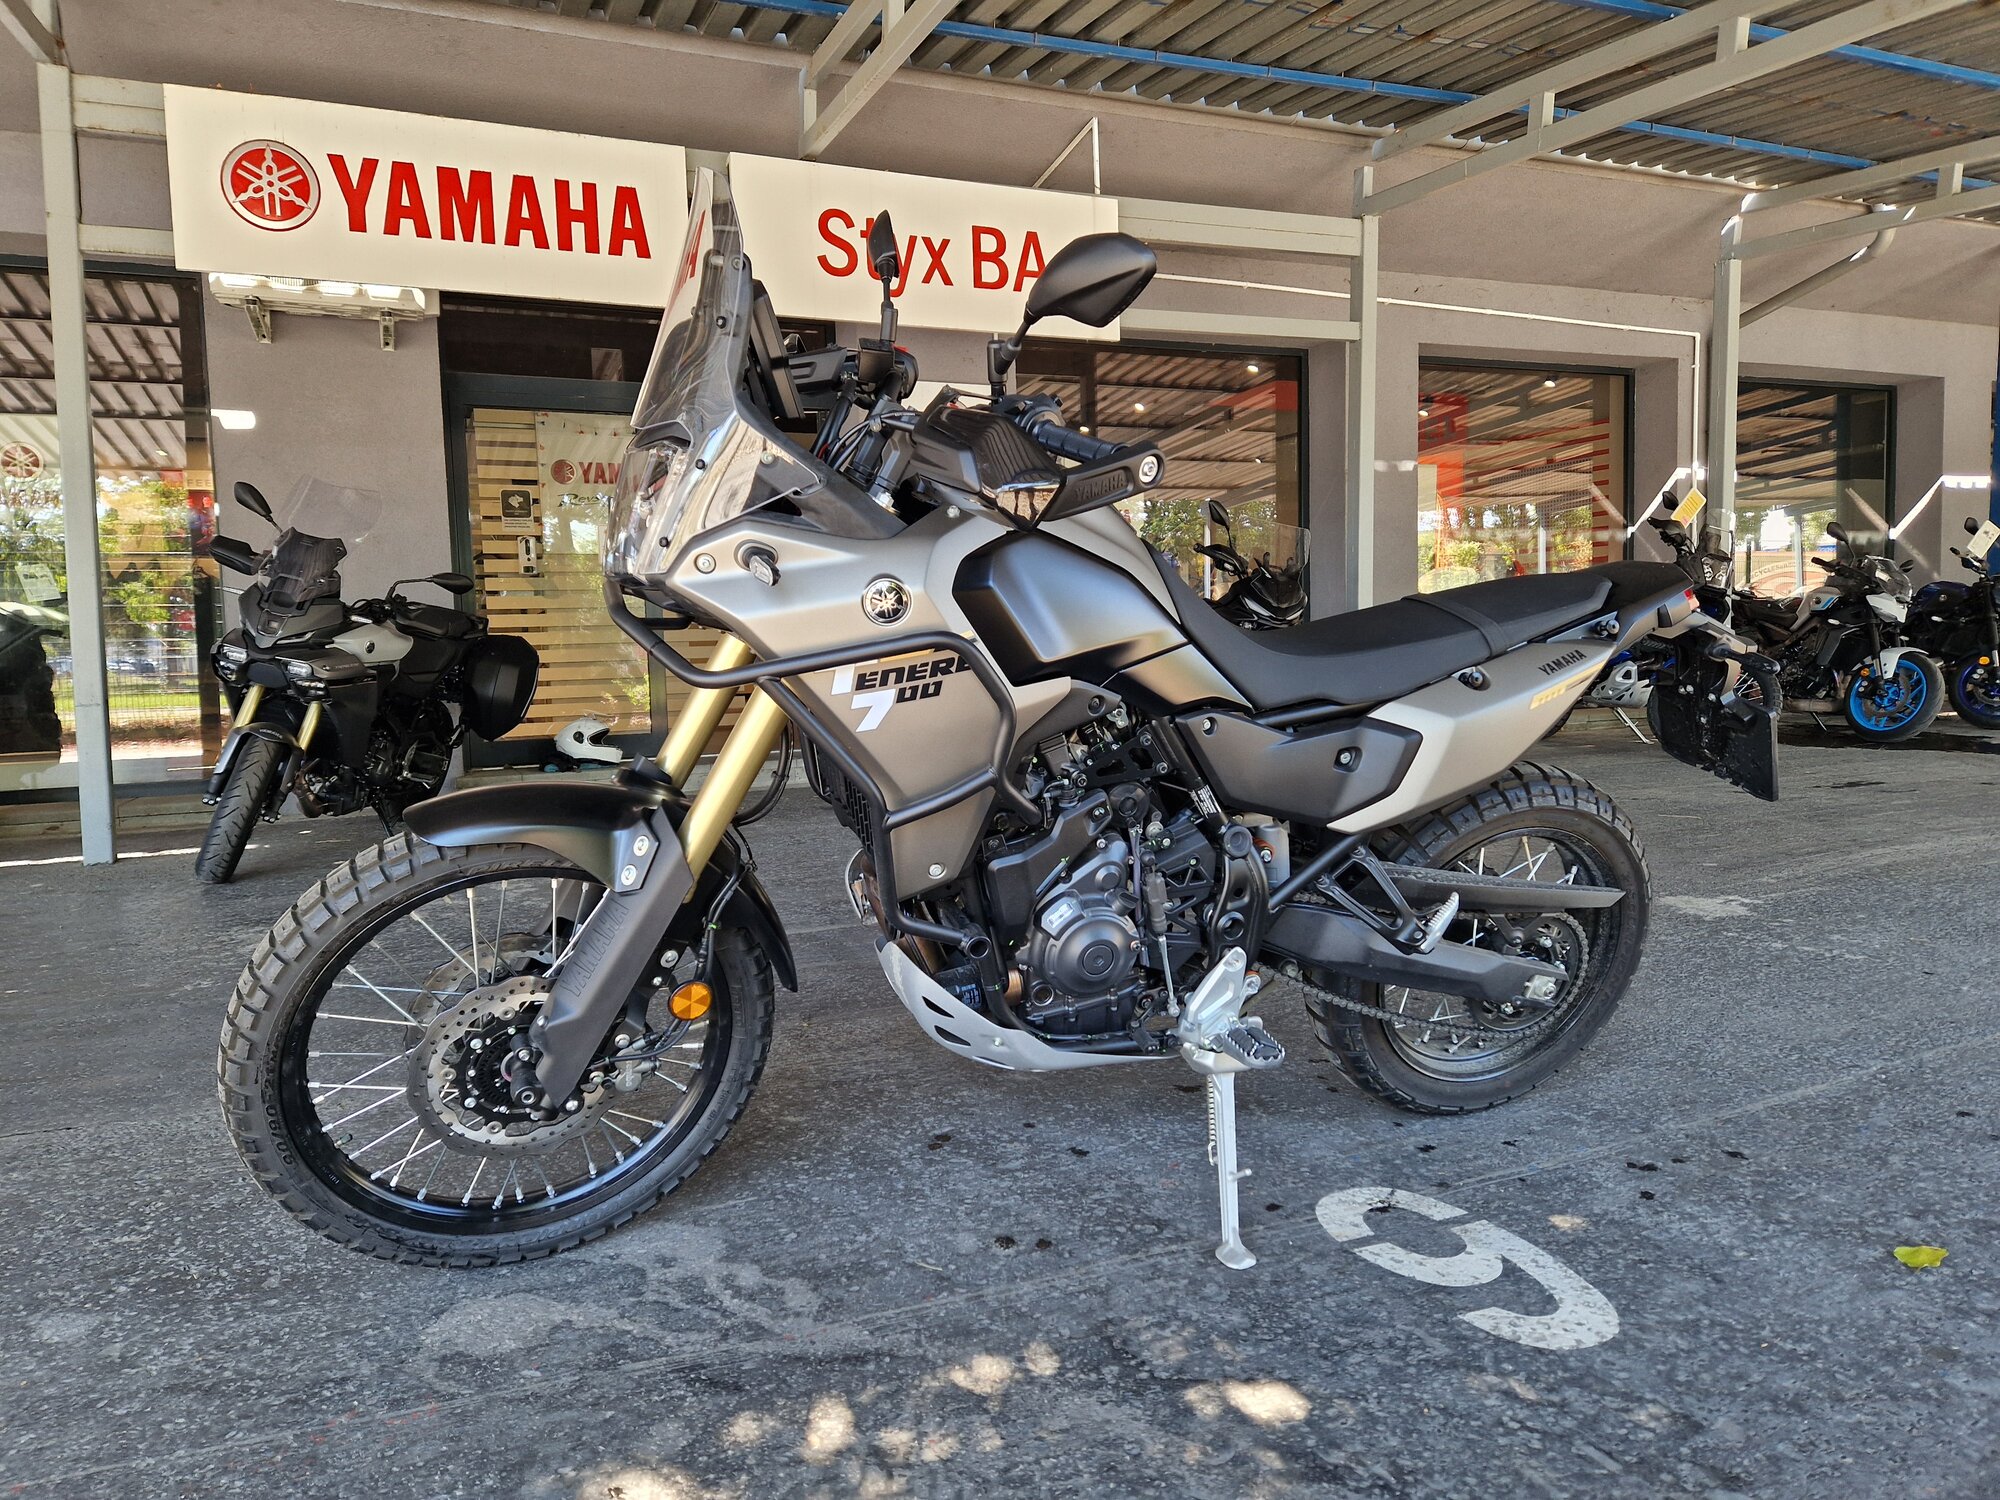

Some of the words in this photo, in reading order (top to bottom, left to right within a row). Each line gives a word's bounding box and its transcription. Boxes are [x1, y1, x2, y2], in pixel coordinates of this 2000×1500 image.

[327, 153, 651, 259] YAMAHA
[1075, 474, 1127, 500] YAMAHA
[1538, 649, 1587, 676] YAMAHA
[851, 680, 943, 733] 700
[560, 898, 630, 997] YAMAHA
